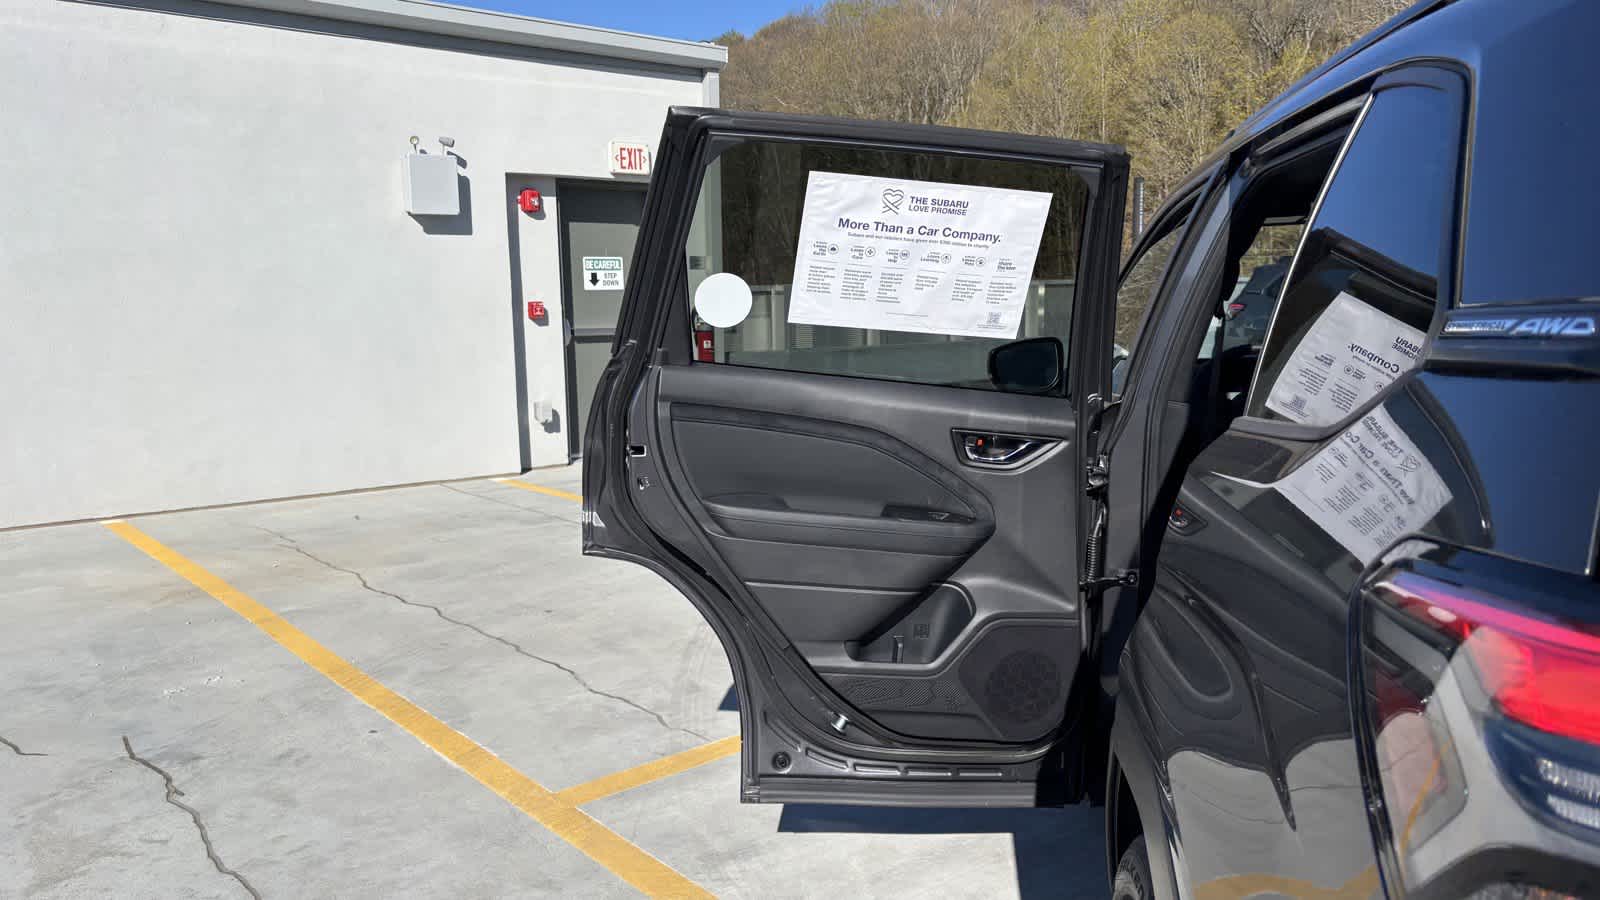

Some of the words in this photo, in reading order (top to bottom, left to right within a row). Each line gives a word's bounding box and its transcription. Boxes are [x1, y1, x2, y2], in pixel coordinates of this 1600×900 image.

[619, 147, 644, 170] EXIT
[910, 196, 929, 206] THE
[930, 199, 969, 209] SUBARU
[908, 205, 929, 213] LOVE
[930, 207, 968, 216] PROMISE
[838, 217, 870, 231] More
[873, 221, 903, 234] Than
[906, 226, 914, 235] a
[917, 225, 940, 238] Car
[942, 227, 1001, 244] Company.
[585, 260, 593, 269] BE
[593, 260, 620, 269] CAREFUL
[1512, 317, 1595, 335] AWD
